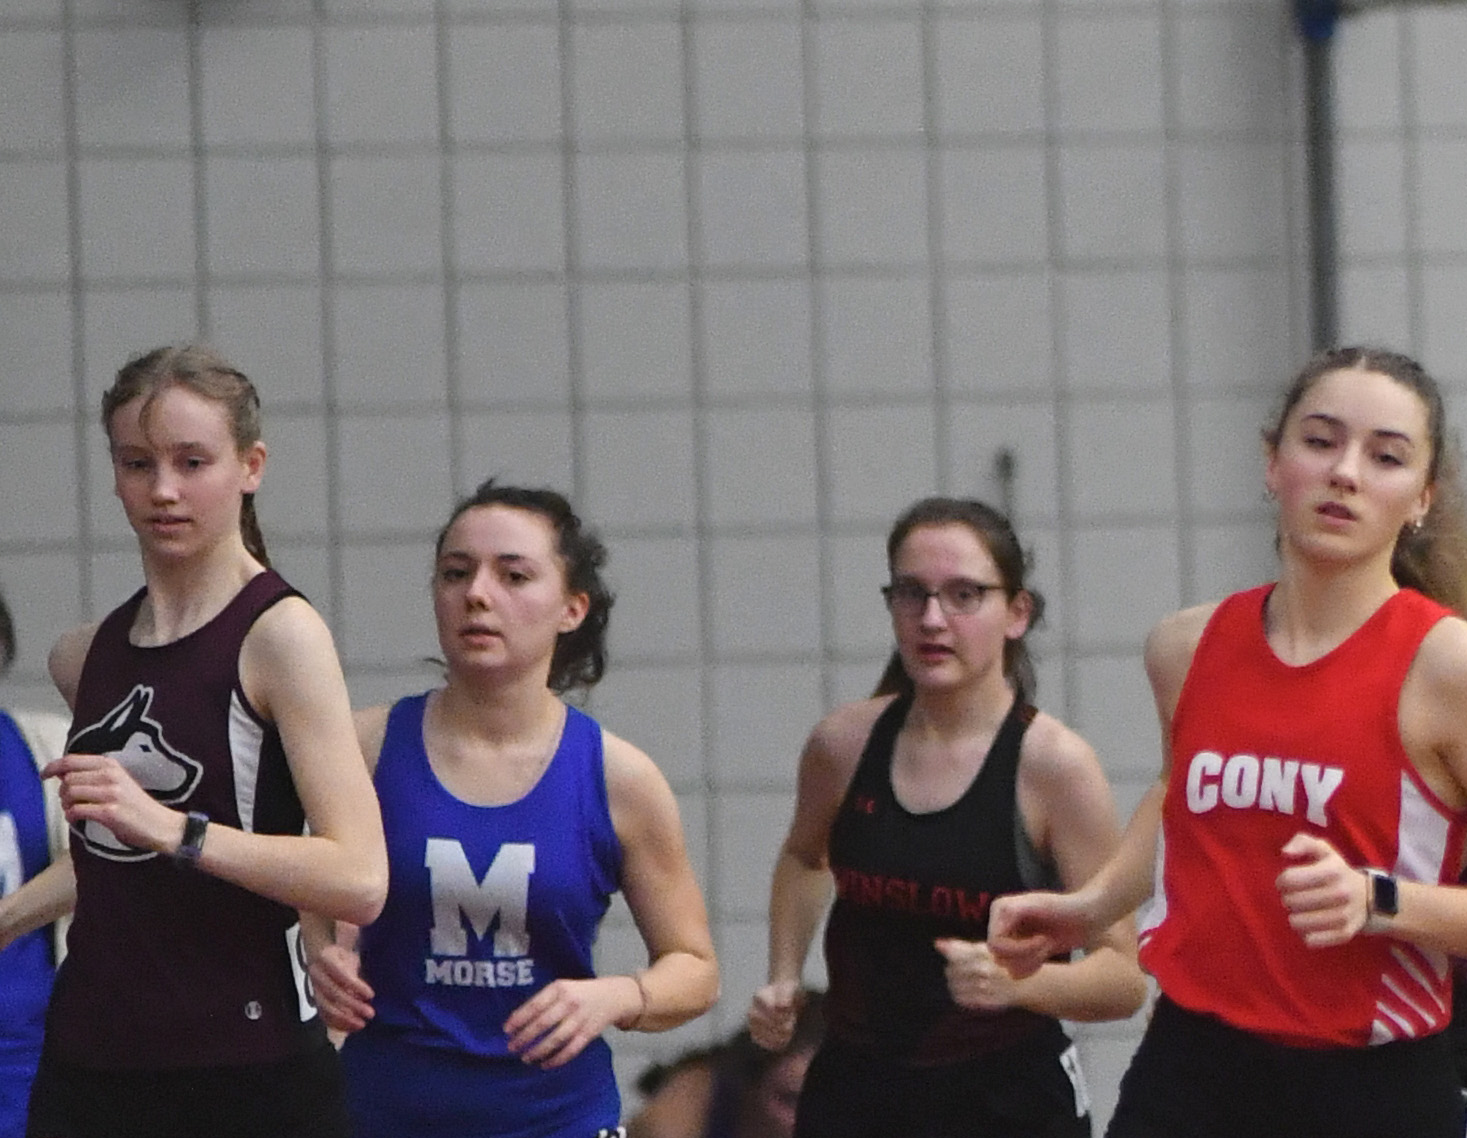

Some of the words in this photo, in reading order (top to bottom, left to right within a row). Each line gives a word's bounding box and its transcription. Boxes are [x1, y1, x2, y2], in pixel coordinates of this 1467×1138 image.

[1186, 751, 1344, 828] CONY
[425, 837, 536, 957] M
[425, 958, 535, 988] MORSE
